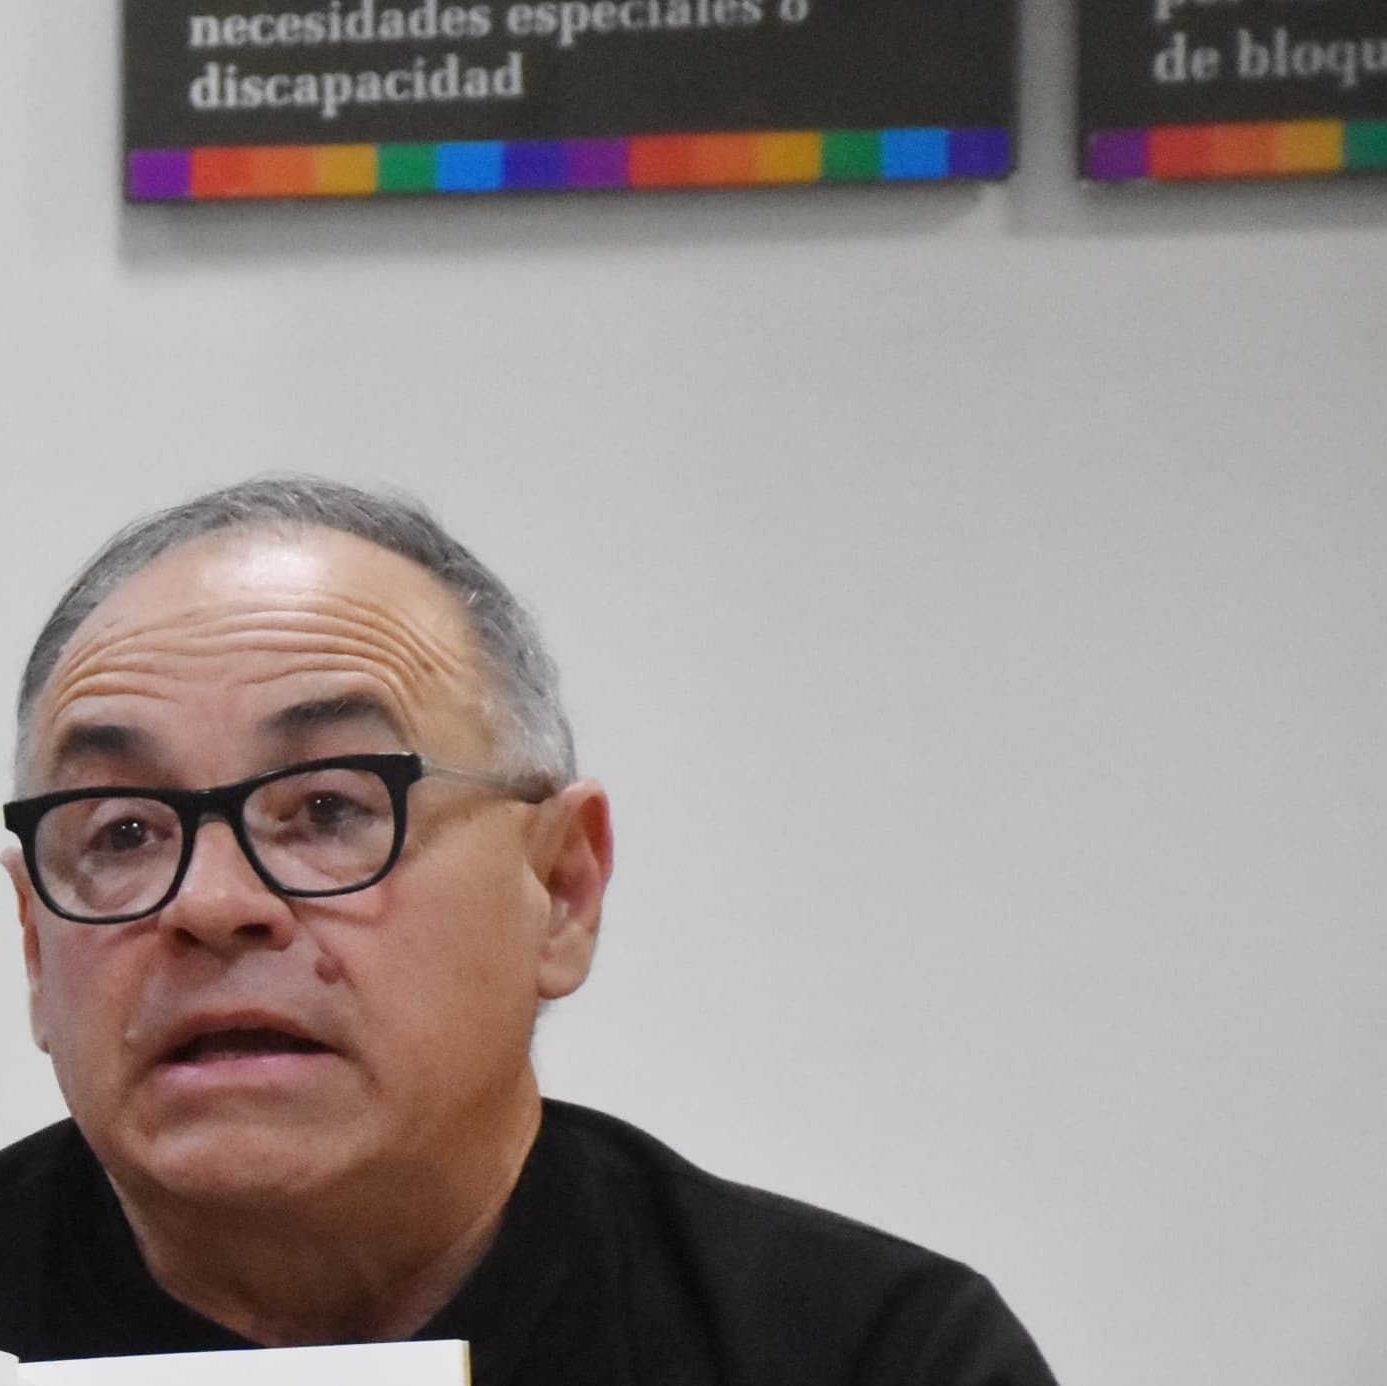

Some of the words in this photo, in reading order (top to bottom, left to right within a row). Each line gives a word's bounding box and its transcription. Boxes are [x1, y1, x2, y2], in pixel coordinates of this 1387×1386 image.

[189, 0, 491, 48] necesidades
[506, 0, 764, 47] especiales
[1153, 31, 1222, 83] de
[188, 50, 525, 119] discapacidad
